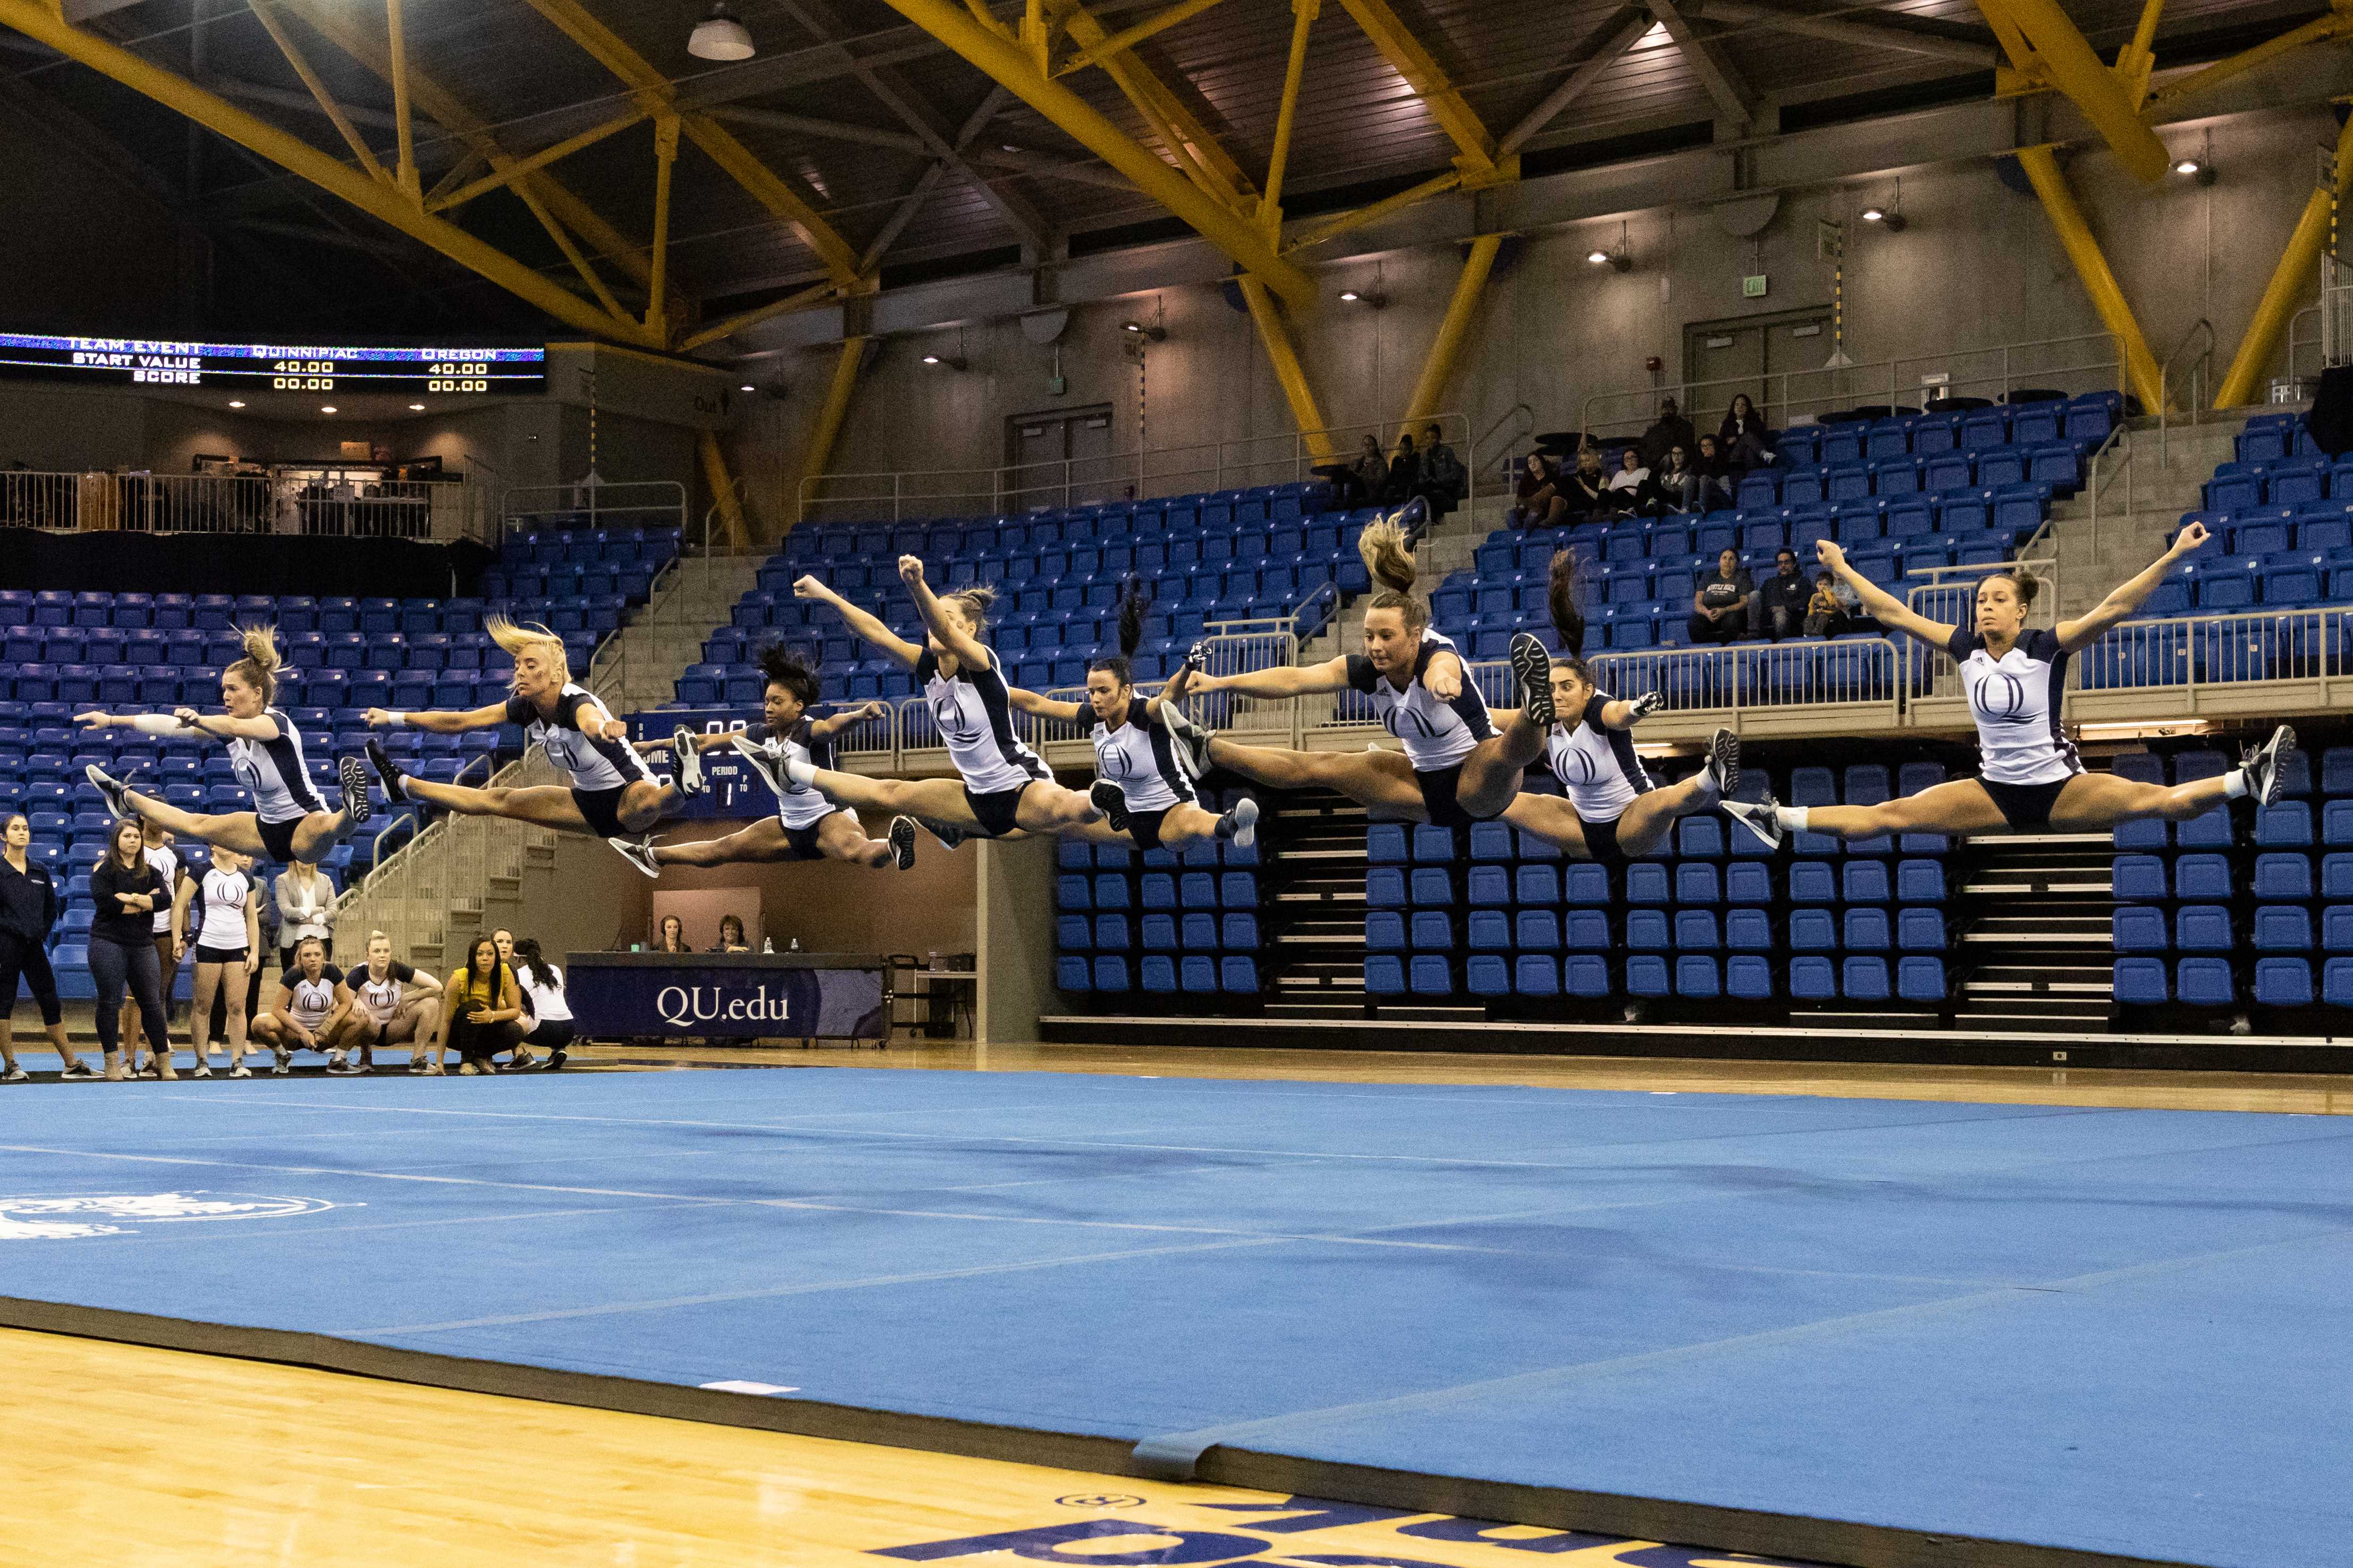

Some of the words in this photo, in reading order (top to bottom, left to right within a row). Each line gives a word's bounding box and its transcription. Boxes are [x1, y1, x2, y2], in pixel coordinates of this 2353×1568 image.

[68, 337, 125, 351] TEAM
[134, 341, 204, 354] EVENT
[253, 345, 358, 358] QUINNIPIAC
[73, 352, 133, 366] START
[139, 355, 200, 369] VALUE
[421, 349, 496, 360] OREGON
[274, 361, 333, 373] 40.00
[429, 363, 487, 375] 40.00
[134, 370, 200, 384] SCORE
[274, 378, 333, 389] 00.00
[429, 380, 487, 392] 00.00
[712, 766, 738, 776] PERIOD
[743, 775, 748, 783] P
[739, 784, 748, 792] TO
[727, 783, 732, 806] 1
[657, 985, 789, 1027] QU.edu
